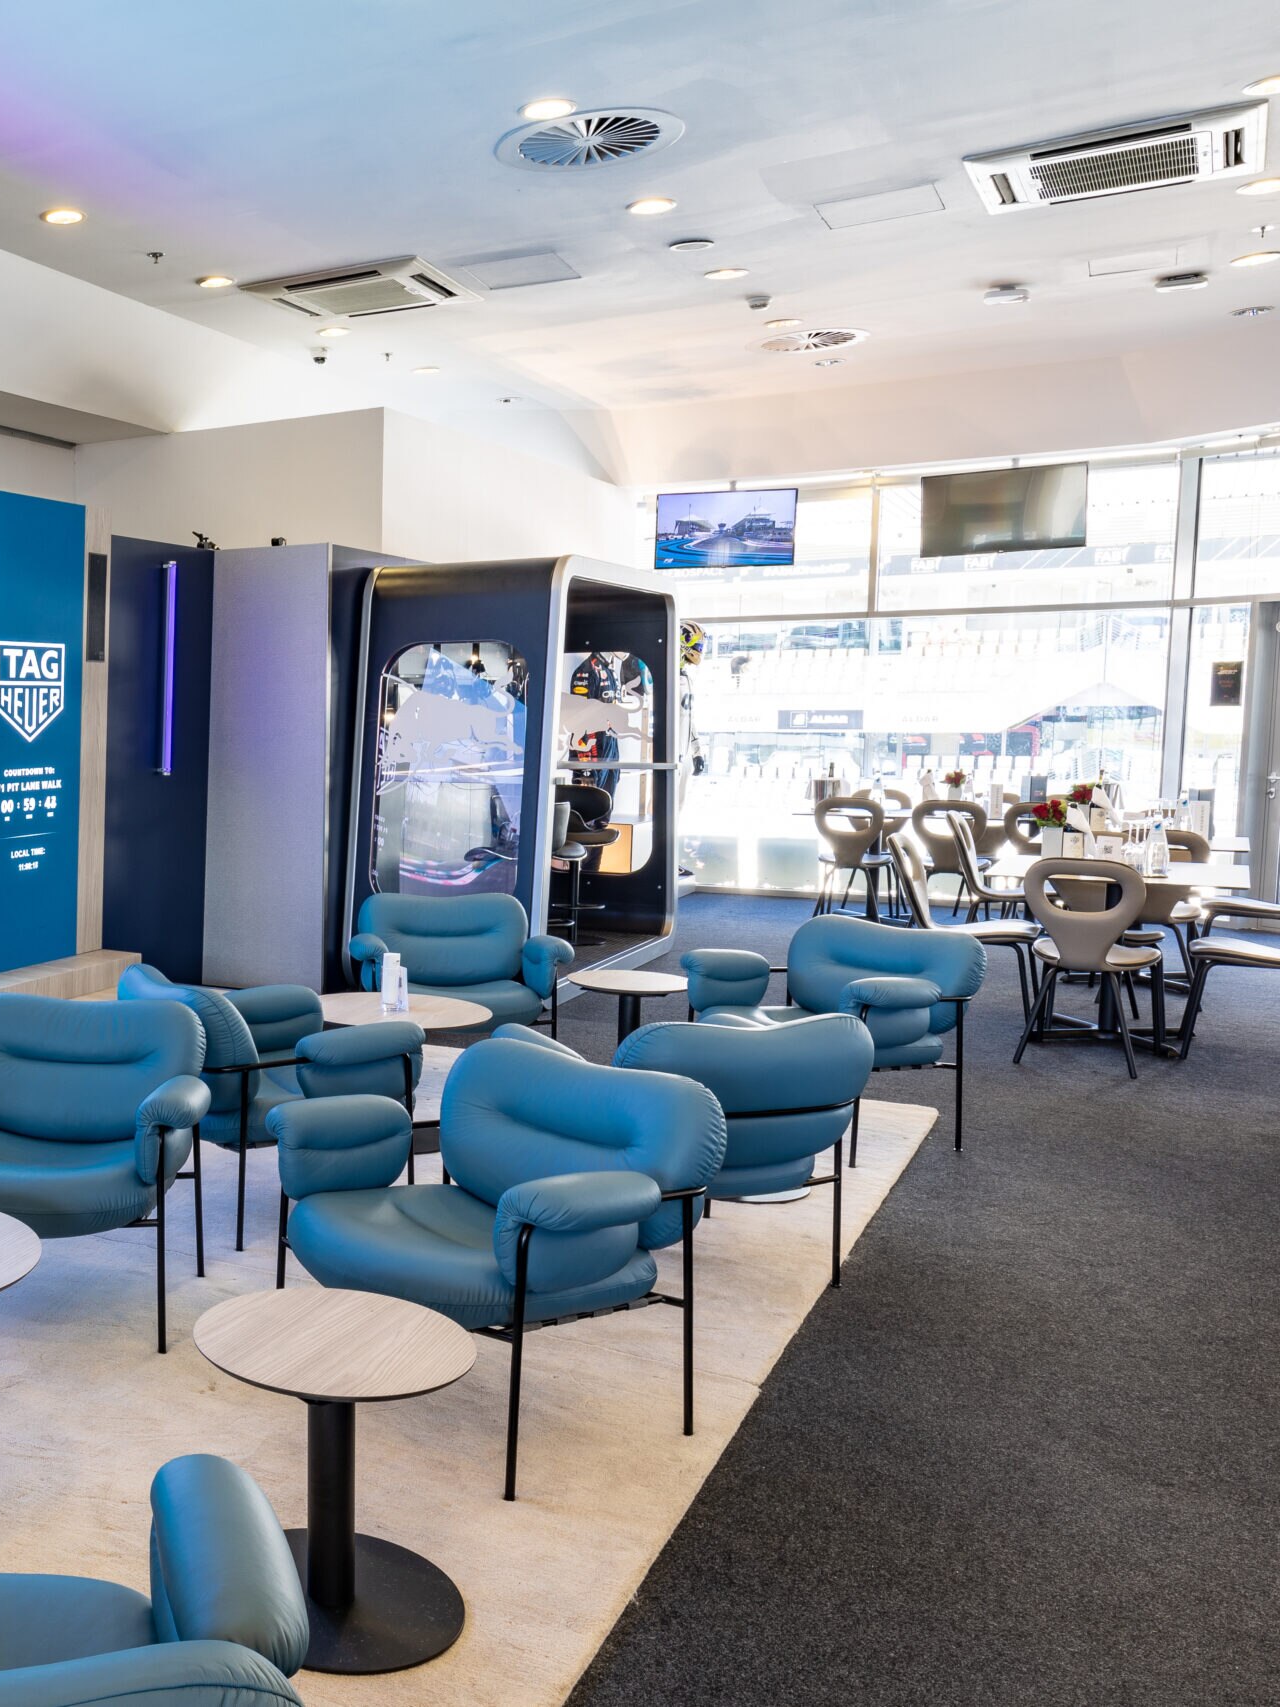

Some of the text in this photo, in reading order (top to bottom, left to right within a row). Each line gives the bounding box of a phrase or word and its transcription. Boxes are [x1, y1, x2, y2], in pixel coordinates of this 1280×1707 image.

[3, 648, 58, 679] TAG
[1, 687, 60, 733] HEUER
[3, 768, 43, 778] COUNTDOWN
[6, 782, 20, 792] PIT
[21, 781, 40, 791] LANE
[41, 779, 62, 790] WALK
[1, 799, 14, 813] 00
[23, 797, 36, 811] 59
[10, 849, 30, 859] LOCAL
